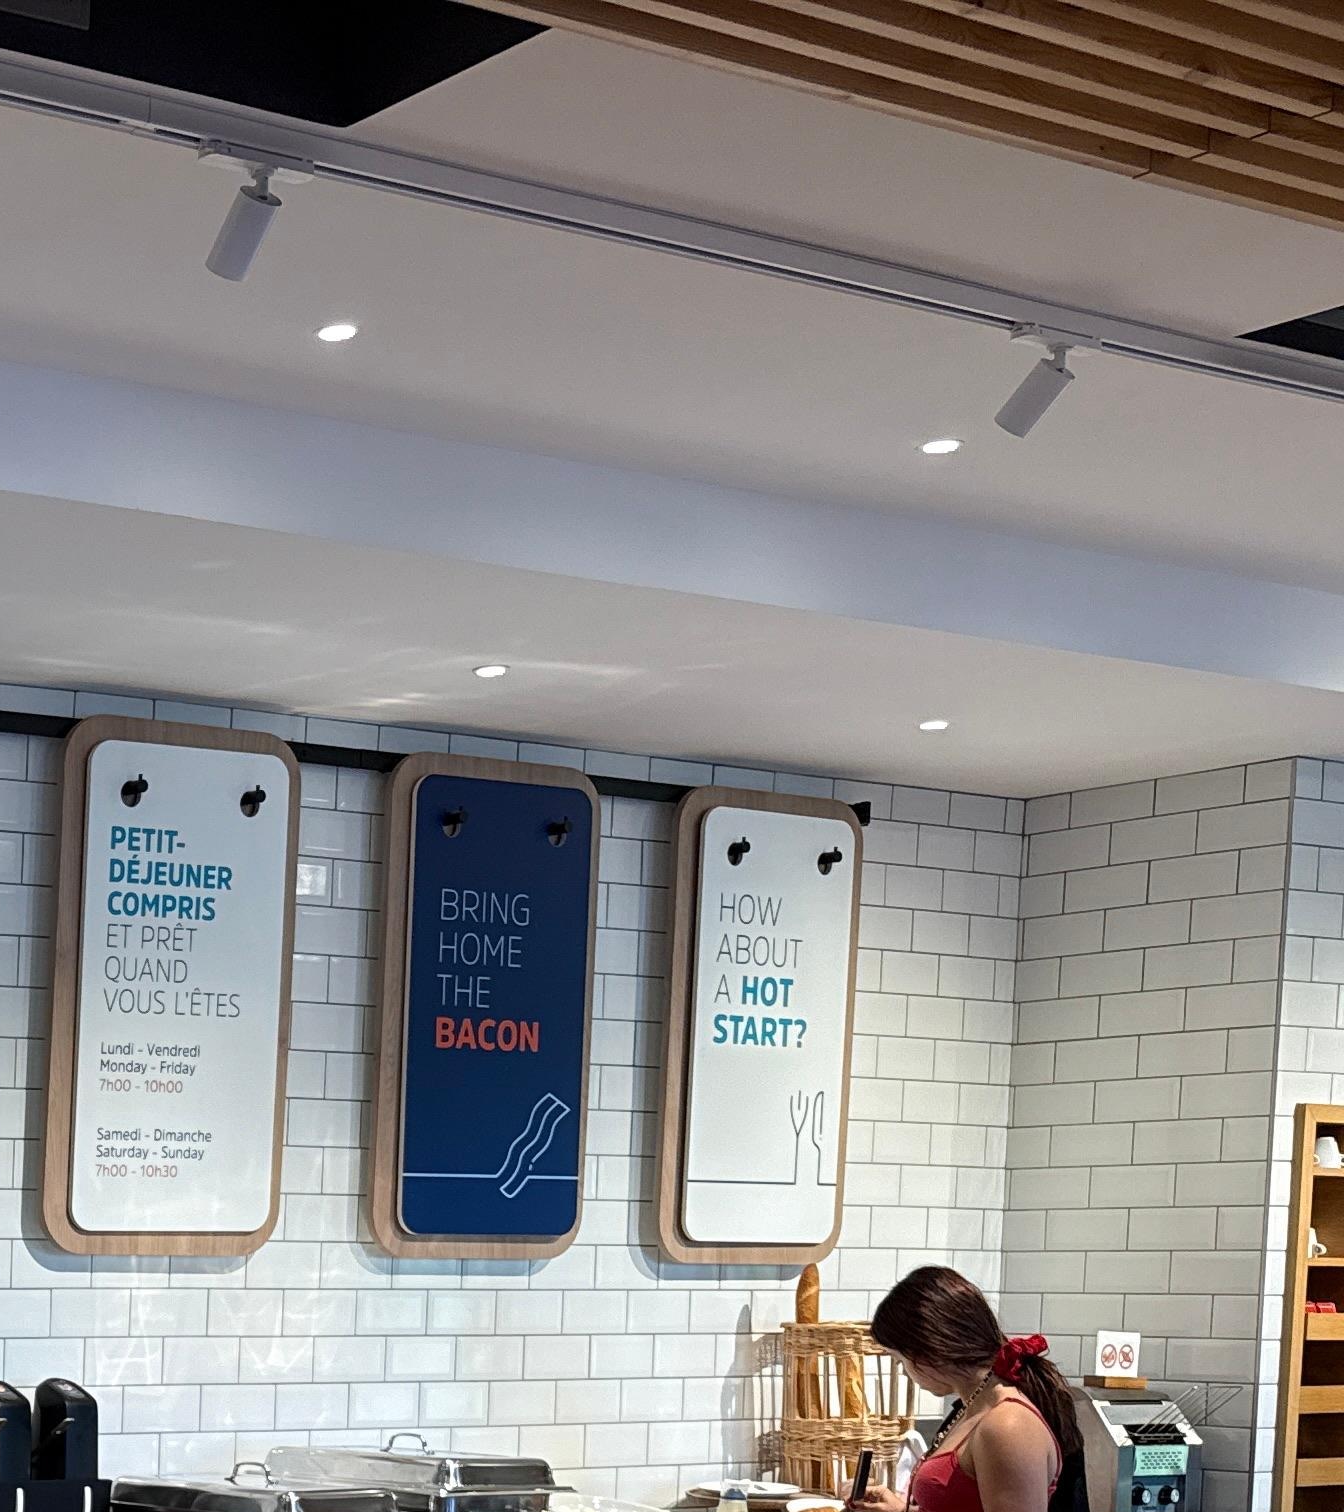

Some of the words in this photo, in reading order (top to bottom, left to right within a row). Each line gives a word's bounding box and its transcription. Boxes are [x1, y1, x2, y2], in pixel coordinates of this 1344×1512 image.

[110, 825, 186, 854] PETIT-
[109, 854, 233, 891] DÉJEUNER
[107, 890, 217, 922] COMPRIS
[440, 888, 530, 927] BRING
[719, 892, 783, 927] HOW
[106, 923, 132, 949] ET
[140, 922, 198, 953] PRÊT
[438, 931, 523, 968] HOME
[716, 933, 804, 969] ABOUT
[104, 955, 189, 984] QUAND
[103, 987, 166, 1015] VOUS
[174, 987, 241, 1019] L'ÊTES
[436, 973, 491, 1009] THE
[713, 973, 731, 1004] A
[741, 975, 794, 1008] HOT
[435, 1015, 540, 1053] BACON
[712, 1013, 808, 1049] START?
[100, 1041, 134, 1056] Lundi
[146, 1042, 201, 1058] Vendredi
[99, 1058, 148, 1075] Monday
[159, 1060, 196, 1077] Friday
[99, 1078, 132, 1093] 7h00
[143, 1079, 184, 1094] 10h00
[96, 1127, 141, 1142] Samedi
[153, 1128, 213, 1143] Dimanche
[95, 1144, 150, 1161] Saturday
[160, 1145, 205, 1161] Sunday
[95, 1163, 128, 1178] 7h00
[140, 1164, 179, 1179] 10h30
